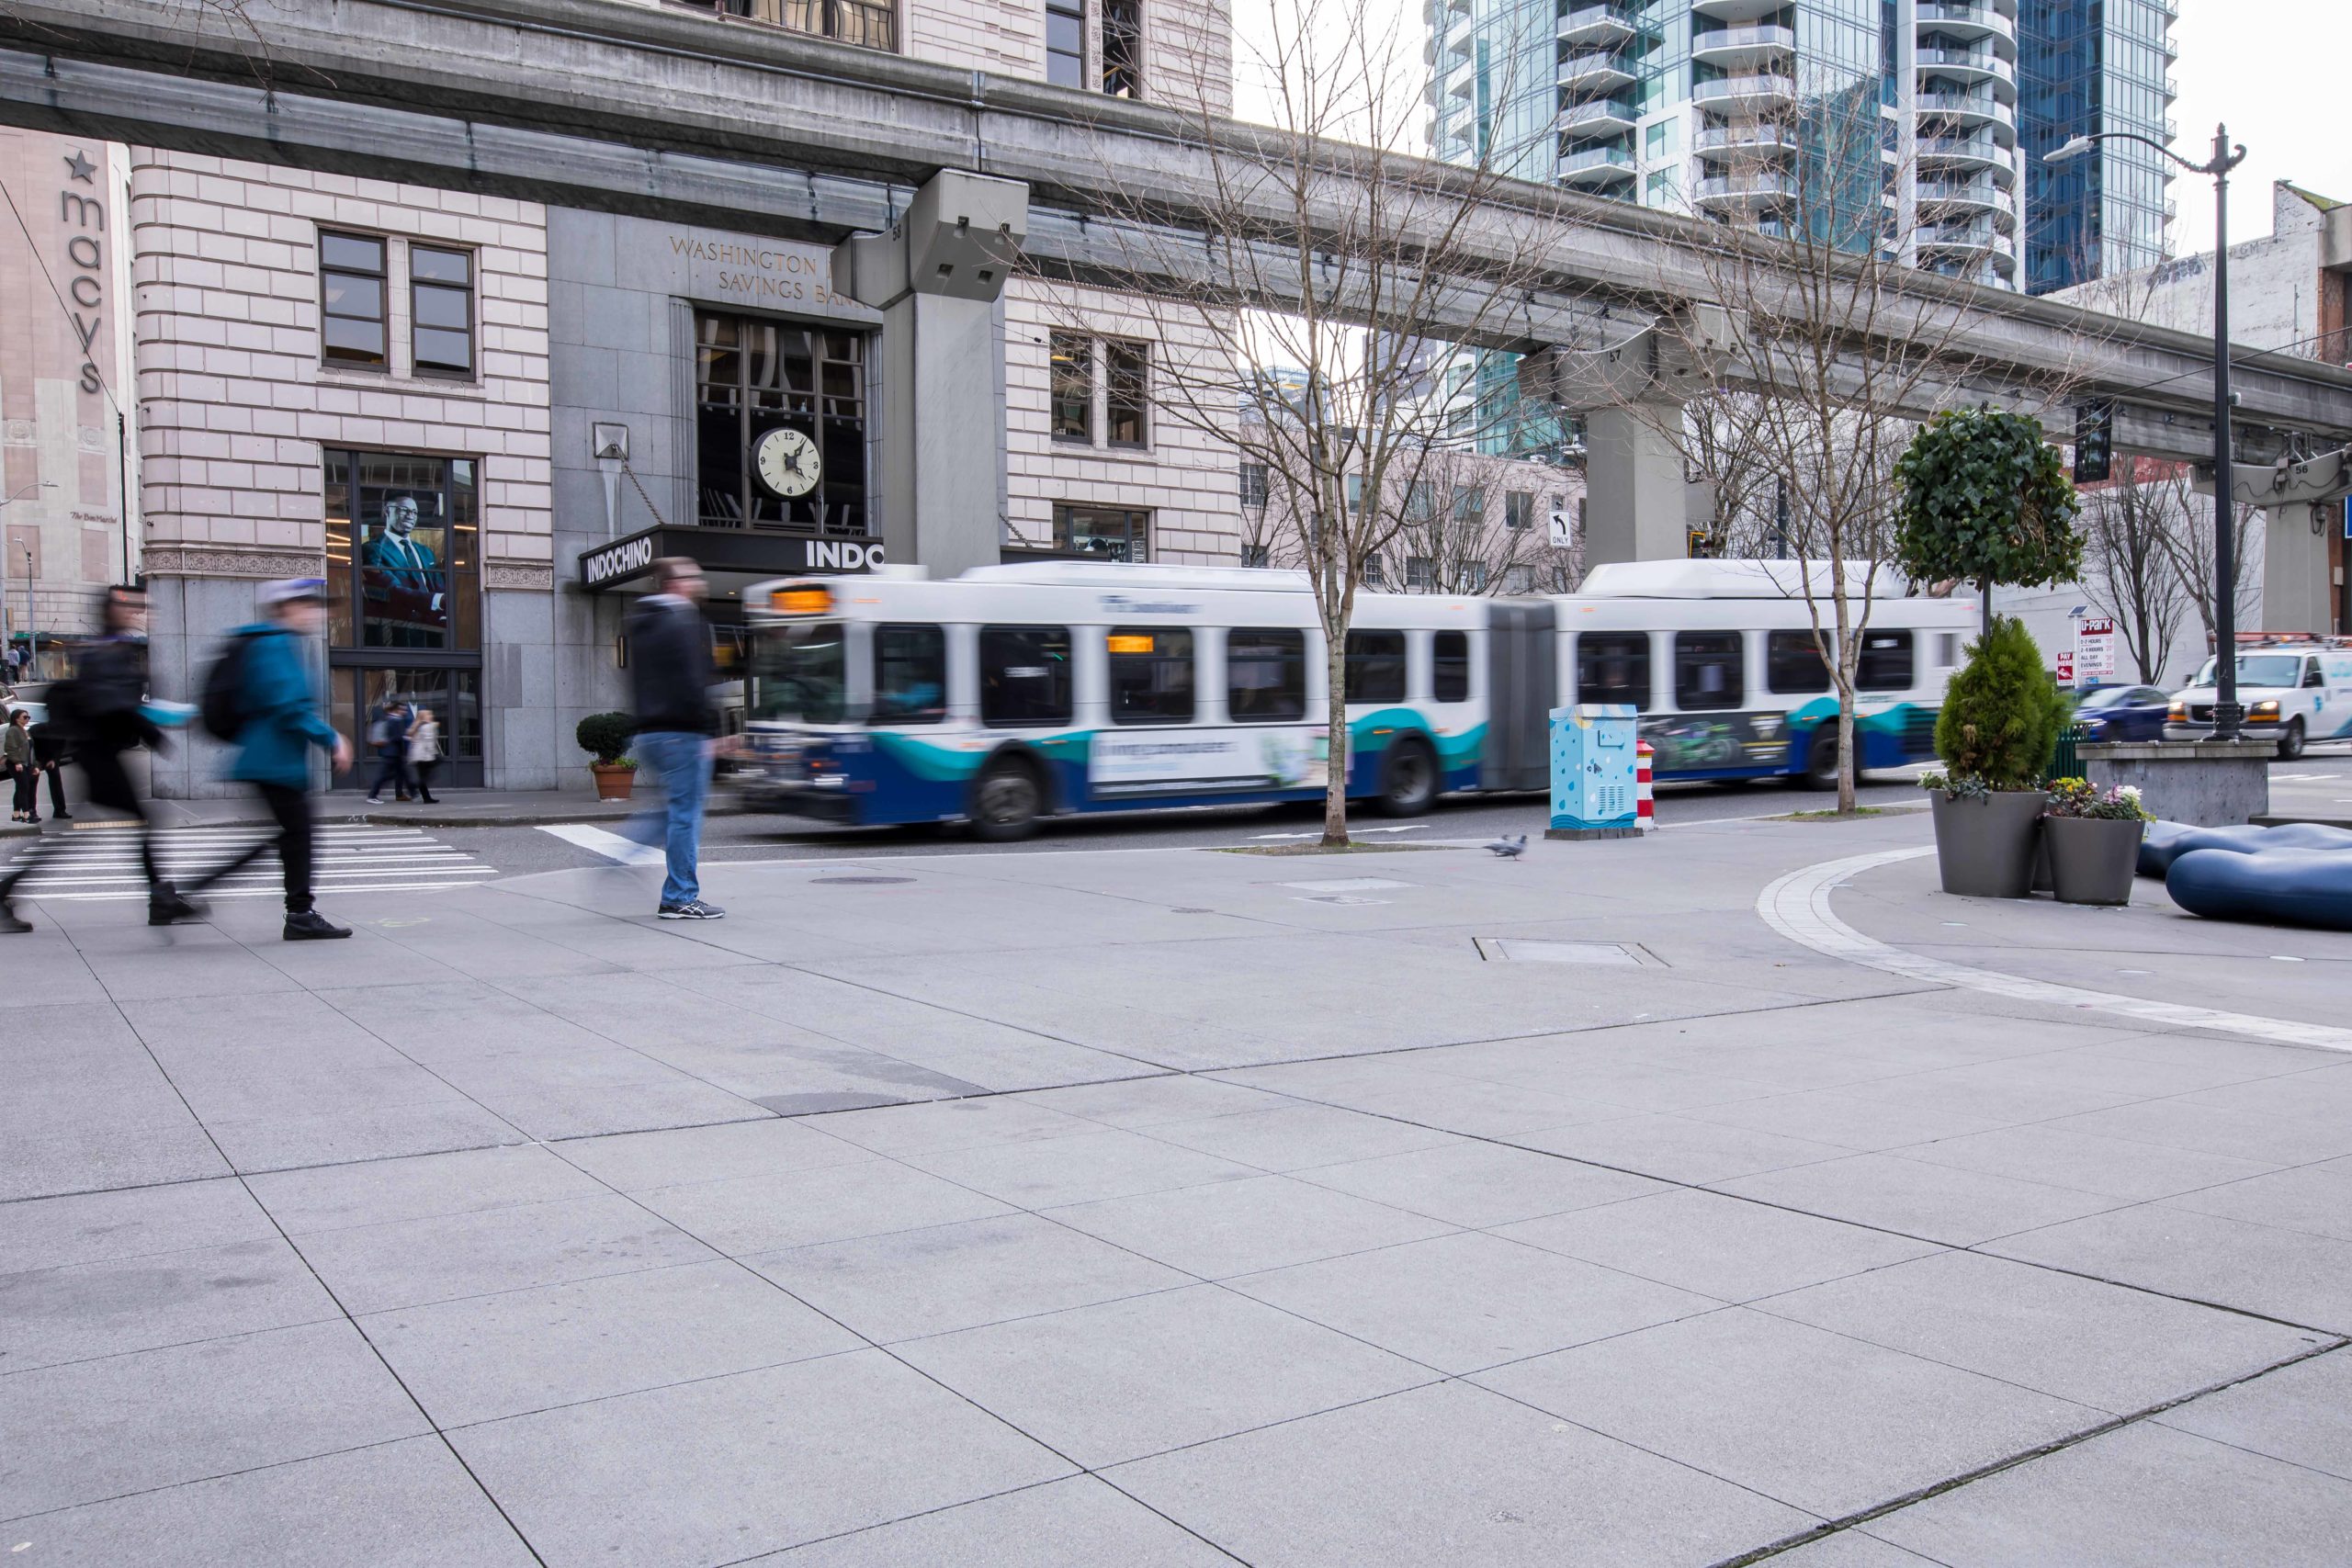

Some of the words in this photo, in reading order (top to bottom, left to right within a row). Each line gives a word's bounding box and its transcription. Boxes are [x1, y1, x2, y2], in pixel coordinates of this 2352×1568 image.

[892, 223, 901, 242] 58
[669, 236, 816, 275] WASHINGTON
[718, 271, 803, 299] SAVINGS
[815, 285, 868, 309] BAN
[1610, 349, 1621, 363] 57
[784, 432, 795, 441] 12
[760, 457, 766, 466] 9
[813, 461, 819, 470] 3
[2295, 465, 2309, 475] 56
[786, 486, 793, 494] 6
[1553, 536, 1568, 545] ONLY
[587, 536, 652, 583] INDOCHINO
